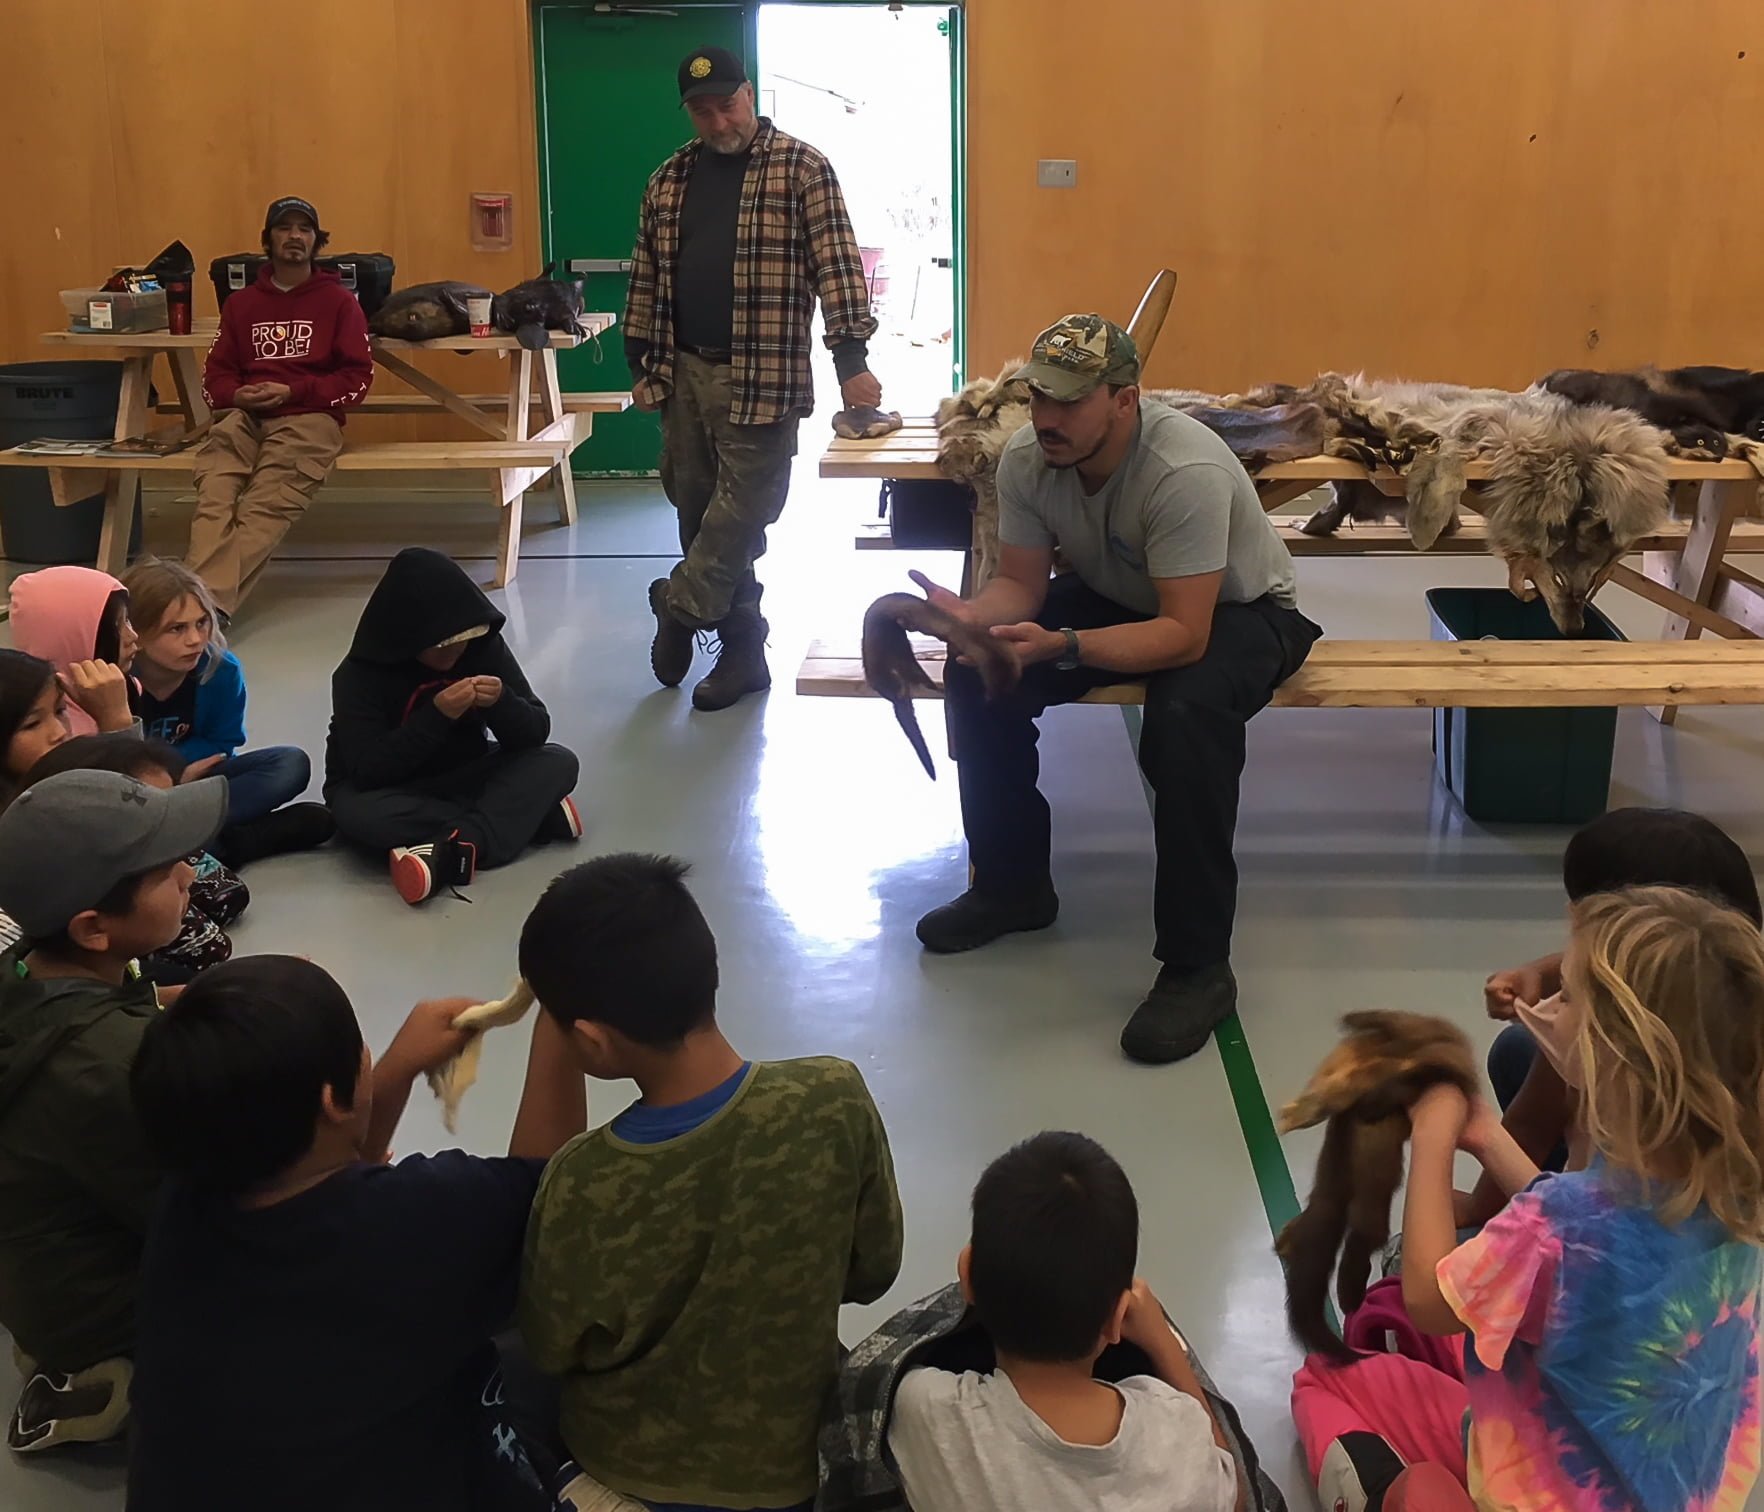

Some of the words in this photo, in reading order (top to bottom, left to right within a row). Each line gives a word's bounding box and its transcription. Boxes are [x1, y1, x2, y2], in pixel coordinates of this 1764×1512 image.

[252, 324, 313, 341] PROUD
[253, 340, 278, 357] TO
[285, 339, 310, 356] BE!
[16, 386, 73, 399] BRUTE
